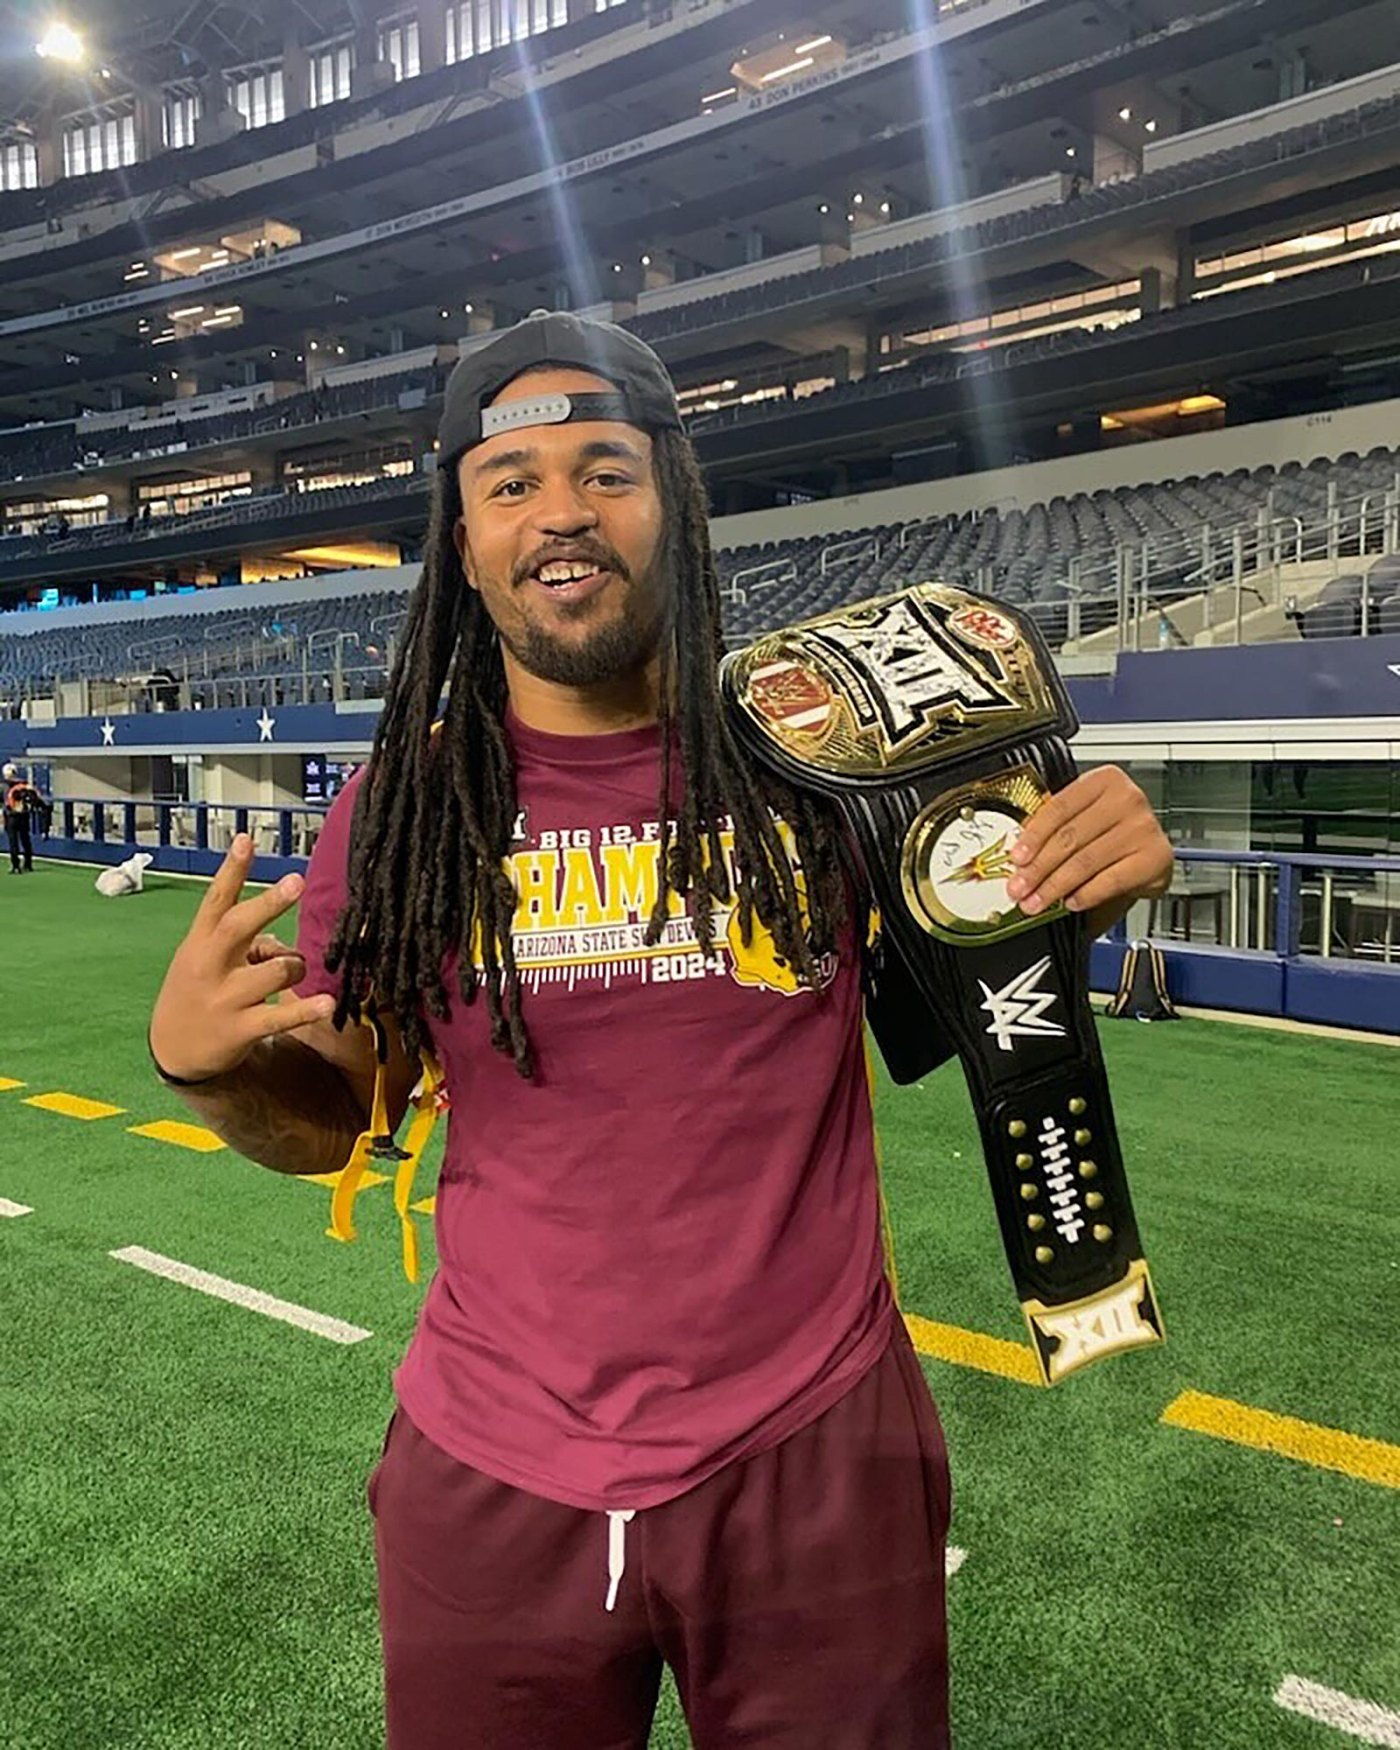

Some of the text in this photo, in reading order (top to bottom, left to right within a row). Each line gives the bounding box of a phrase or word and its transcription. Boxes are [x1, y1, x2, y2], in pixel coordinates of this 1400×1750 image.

[539, 829, 592, 849] BIG
[516, 932, 577, 958] ARIZONA
[582, 924, 627, 951] STATE
[652, 950, 726, 982] 2024
